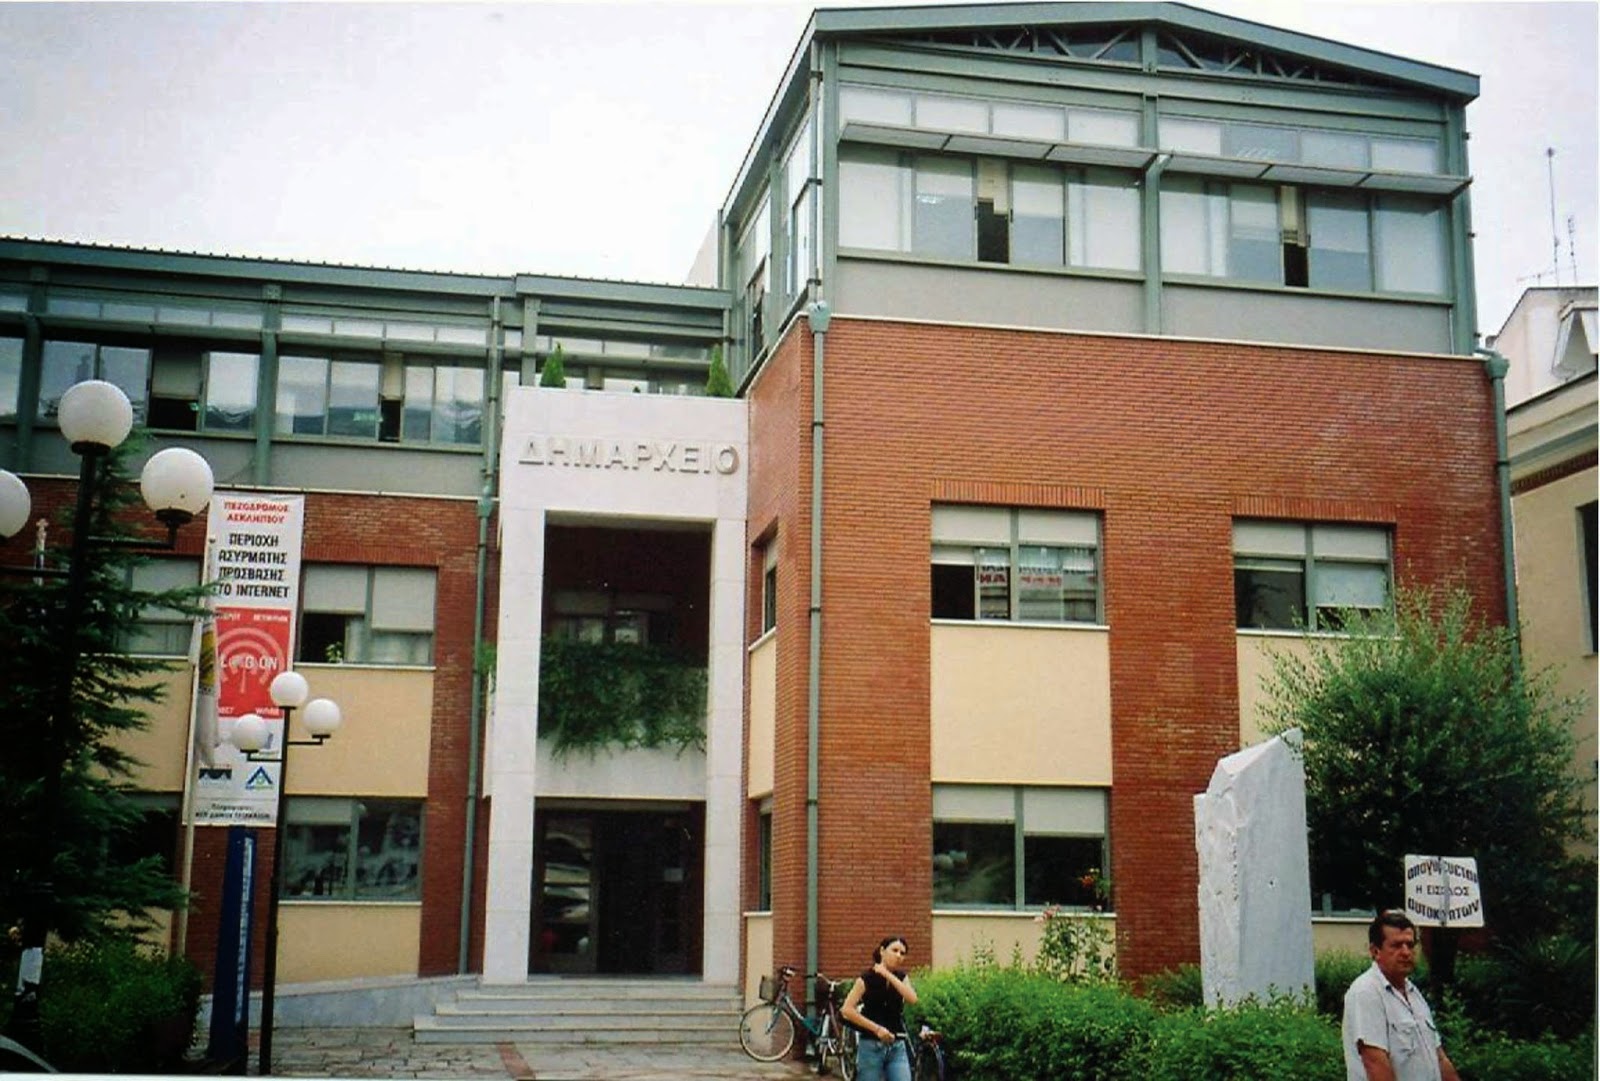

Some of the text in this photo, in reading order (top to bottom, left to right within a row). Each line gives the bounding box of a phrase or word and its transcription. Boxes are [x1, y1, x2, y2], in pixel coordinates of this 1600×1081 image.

[518, 437, 740, 475] ΔΗΜΑΡΧΕΙΟ
[228, 532, 279, 547] ΠΕΡΙΟΧΗ
[218, 549, 288, 564] ΑΣΥΡΜΑΤΗΣ
[219, 566, 285, 581] ΠΡΟΣΒΑΣΗΣ
[236, 583, 290, 598] INTERNET
